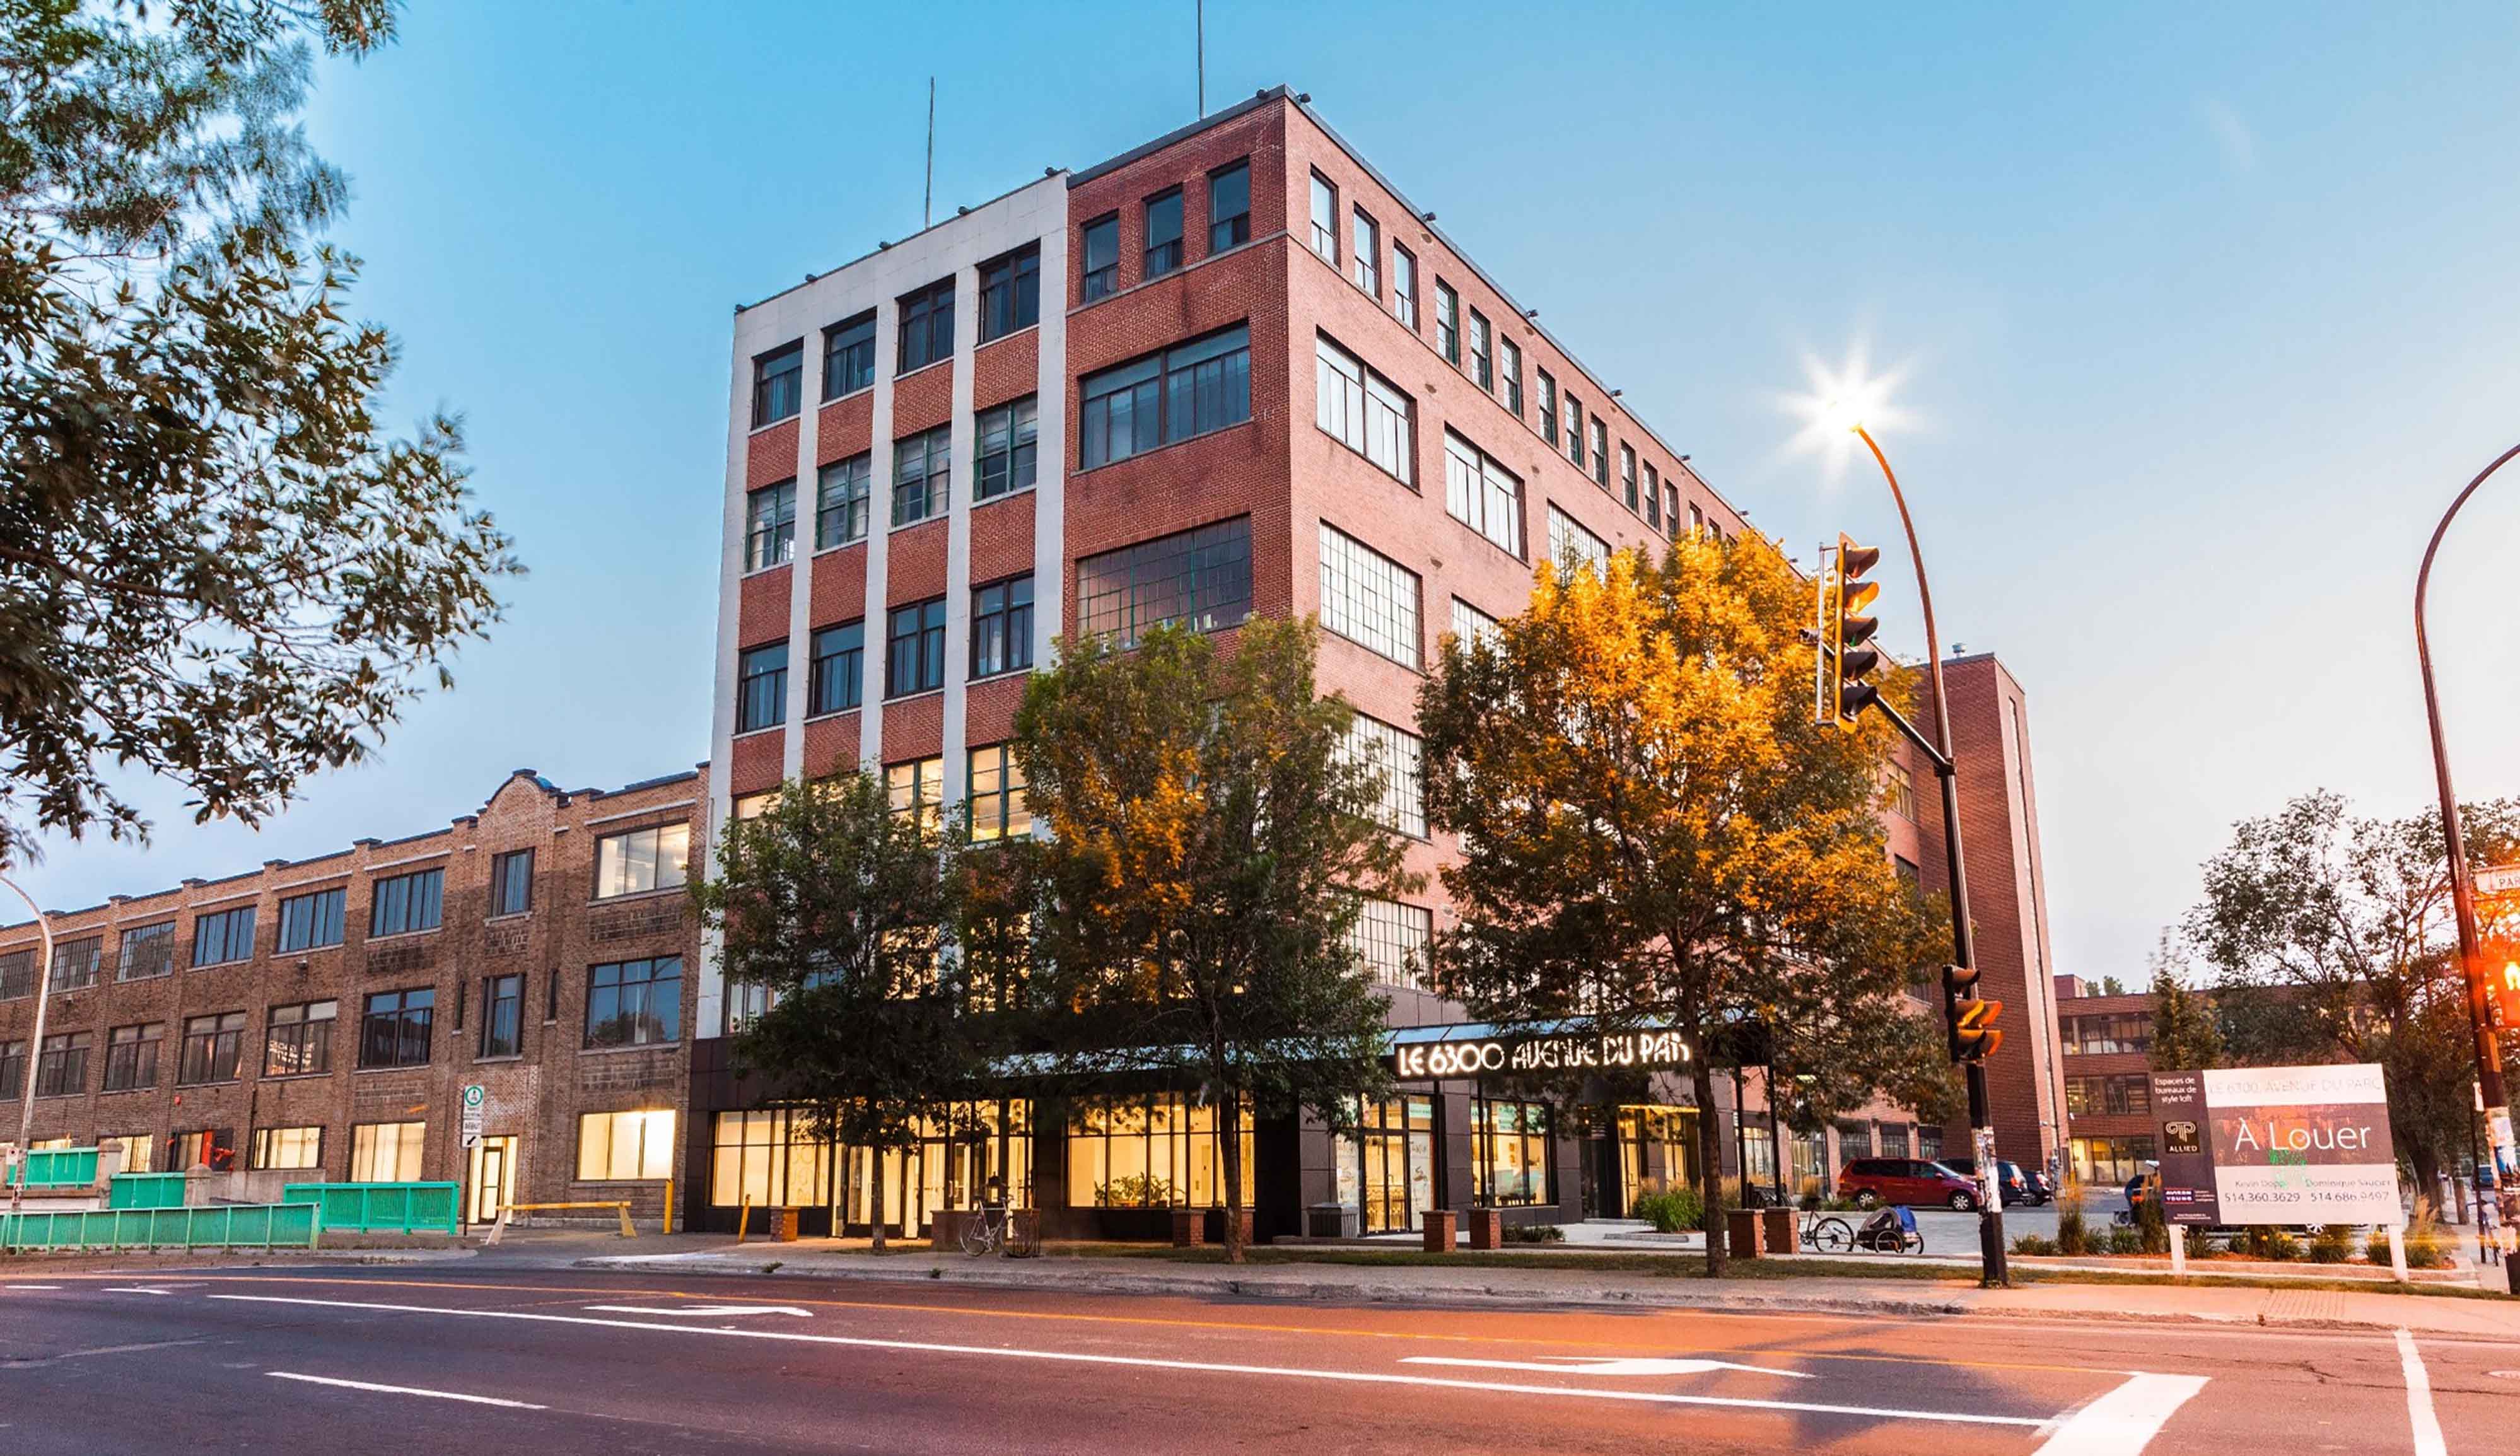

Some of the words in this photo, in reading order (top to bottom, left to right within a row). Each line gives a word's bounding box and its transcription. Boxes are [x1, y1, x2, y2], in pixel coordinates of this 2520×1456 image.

[1399, 1046, 1425, 1076] LE
[1428, 1042, 1505, 1075] 6300
[1602, 1035, 1634, 1066] DU
[1640, 1032, 1692, 1064] PAR
[2155, 1078, 2184, 1086] Espaces
[2346, 1076, 2382, 1091] PARC
[2155, 1086, 2185, 1095] bureaux
[2186, 1085, 2197, 1093] de
[2161, 1095, 2178, 1104] style
[2179, 1095, 2193, 1103] loft
[2235, 1117, 2260, 1151] À
[2269, 1121, 2371, 1151] Louer
[2235, 1180, 2259, 1188] Kevin
[2306, 1179, 2356, 1190] Dominique
